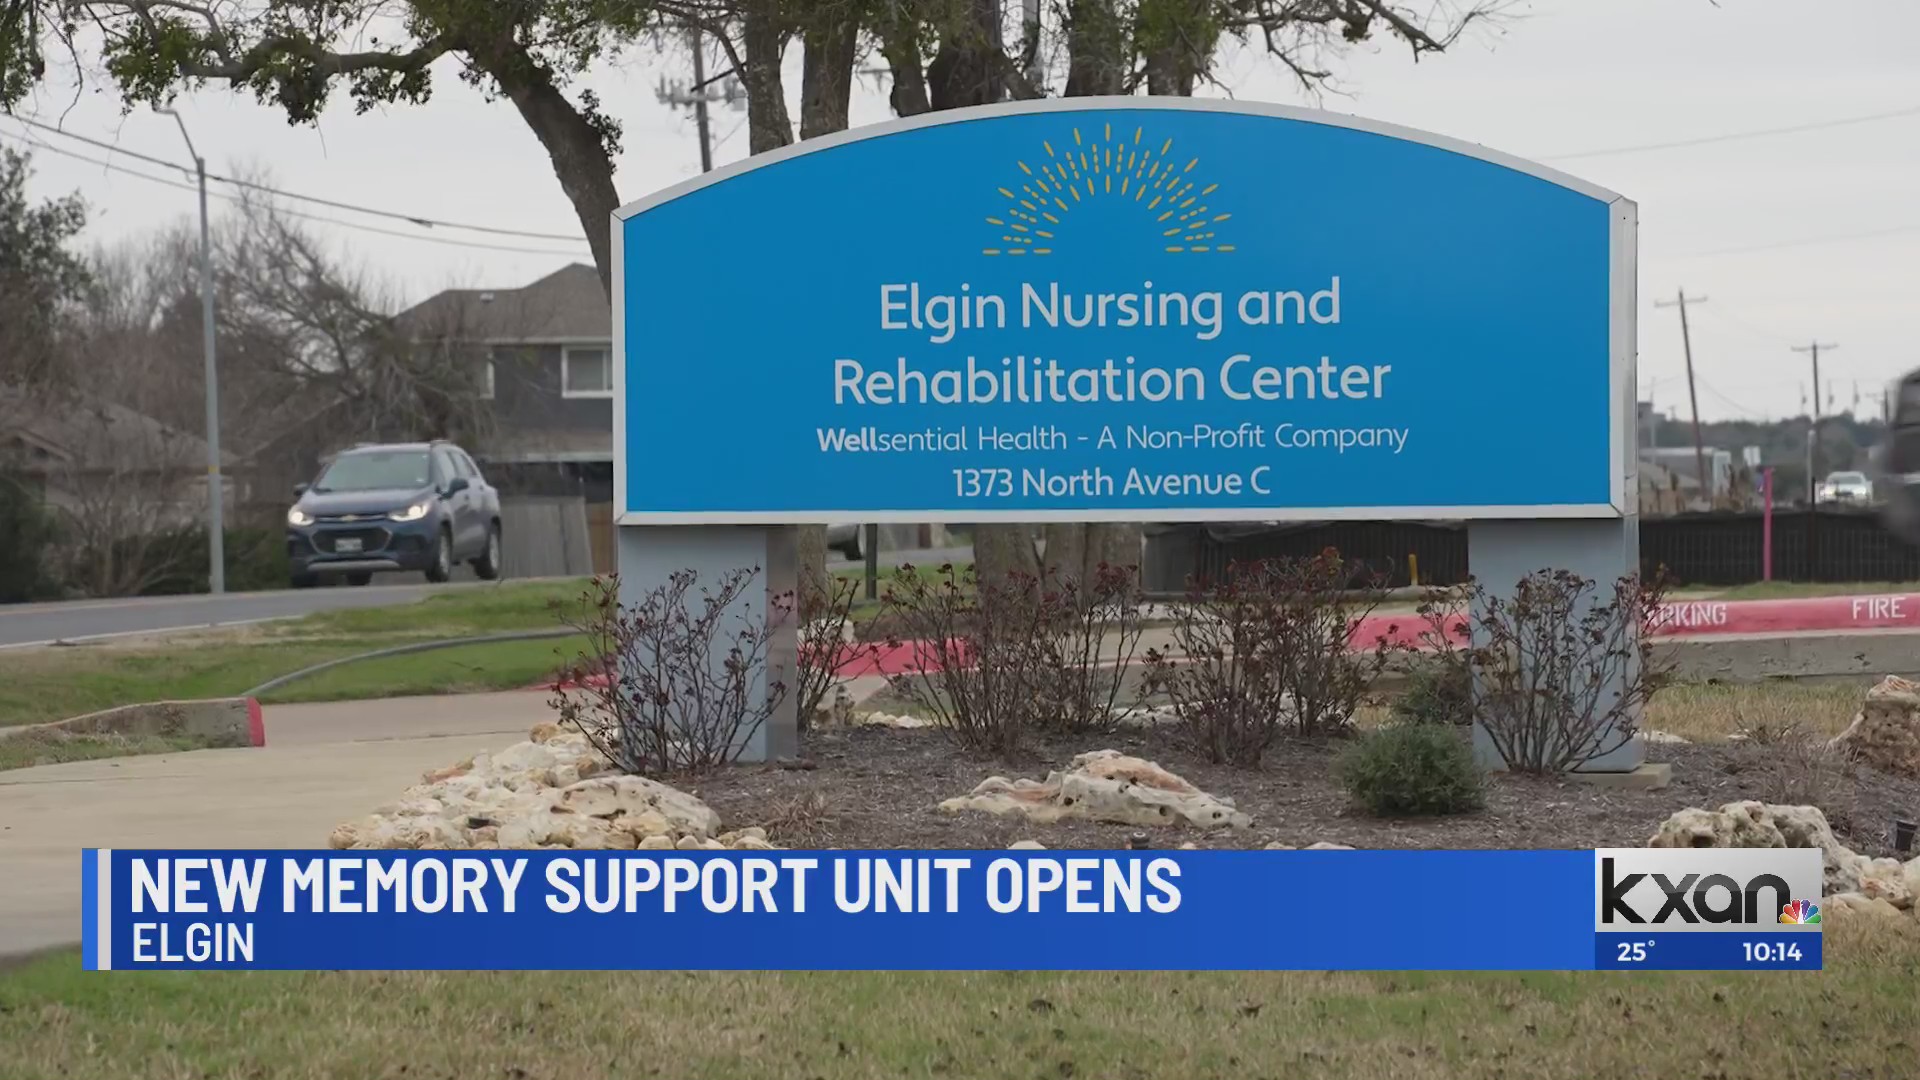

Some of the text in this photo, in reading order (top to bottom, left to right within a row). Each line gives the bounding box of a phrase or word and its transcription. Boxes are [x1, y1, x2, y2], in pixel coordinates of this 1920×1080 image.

[880, 275, 1340, 344] Elgin Nursing and
[834, 354, 1392, 405] Rehabilitation Center
[816, 426, 968, 452] Wellsential
[978, 425, 1067, 450] Health
[1097, 425, 1117, 449] A
[1127, 422, 1266, 449] Non-Profit
[1275, 423, 1410, 454] Company
[952, 465, 1270, 497] 1373 North Avenue C
[1641, 603, 1727, 626] ARKING
[1852, 597, 1907, 620] FIRE
